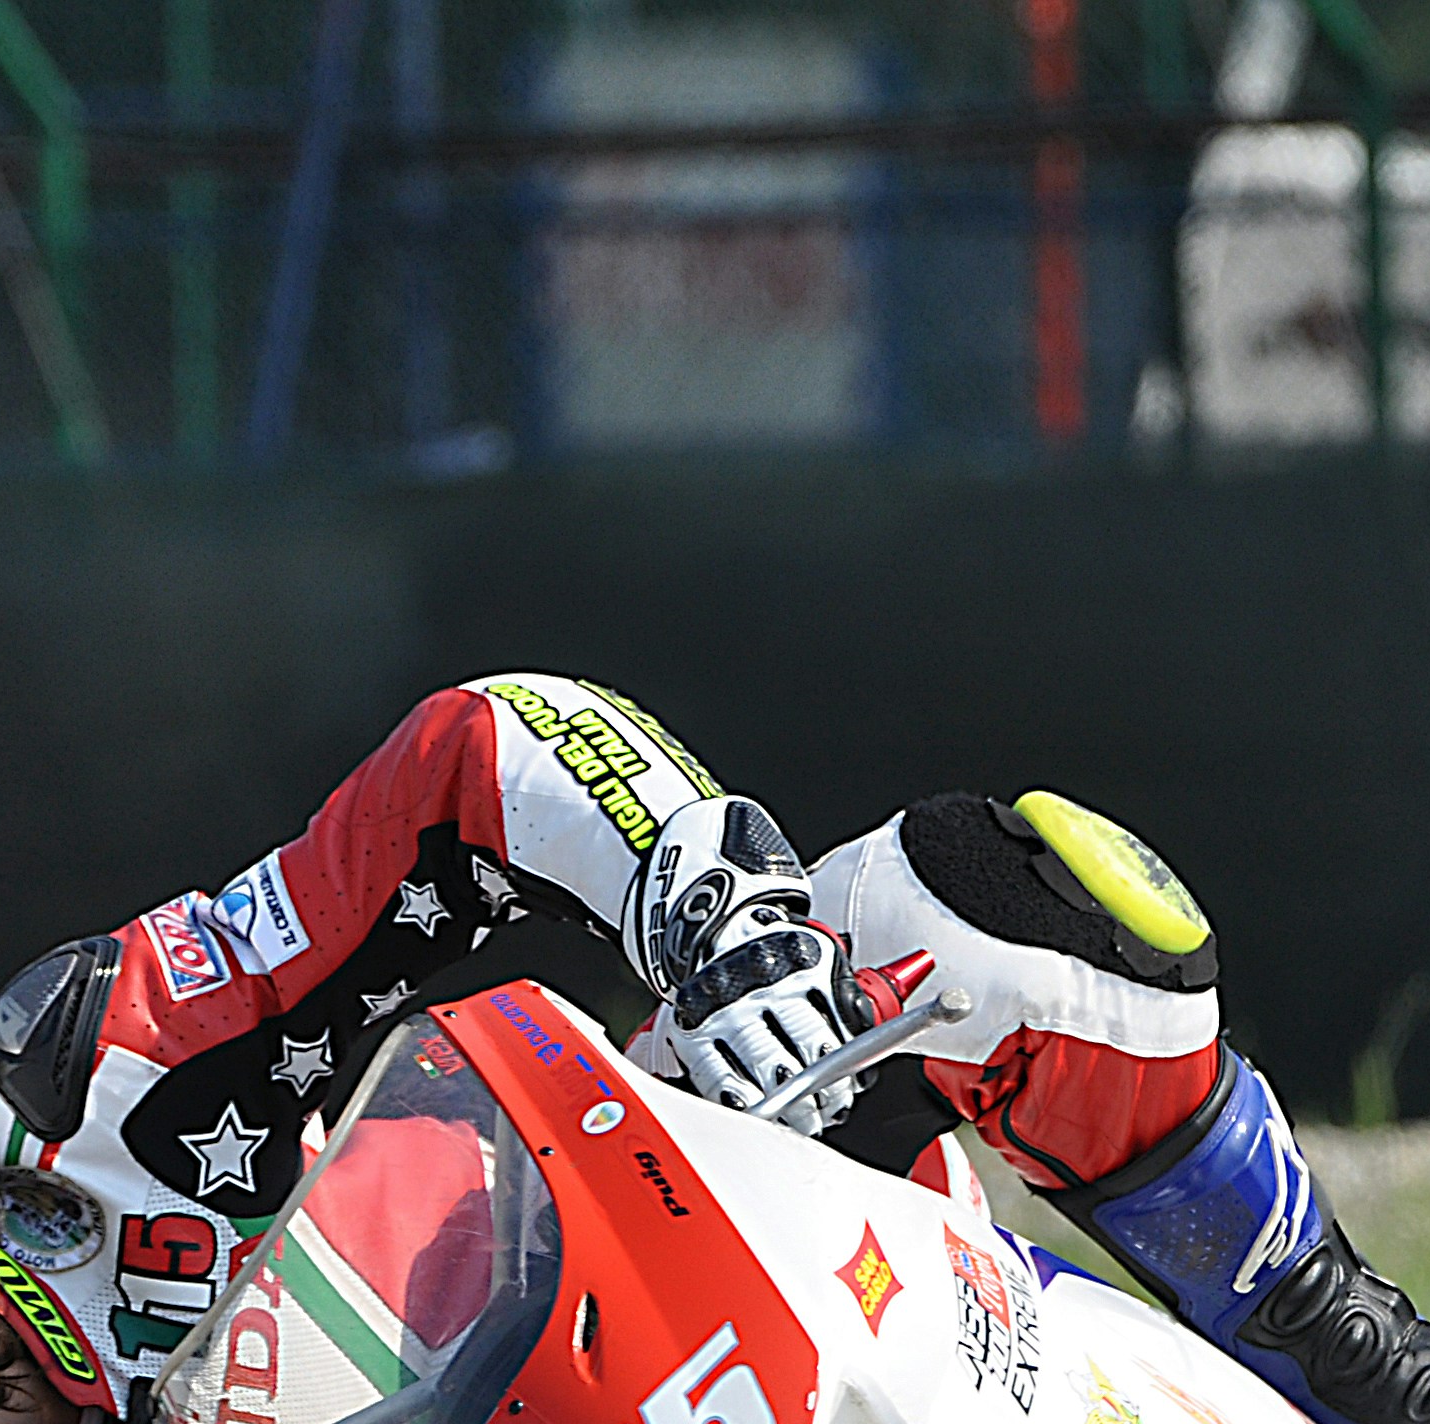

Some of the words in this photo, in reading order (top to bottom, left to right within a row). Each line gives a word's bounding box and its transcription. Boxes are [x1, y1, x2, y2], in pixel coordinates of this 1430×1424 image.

[488, 683, 570, 738] FUOCO
[558, 733, 610, 782] DEL
[569, 709, 647, 778] ITALIA
[649, 845, 683, 993] SPEED
[489, 993, 552, 1048] DUCATO
[634, 1151, 690, 1217] Puig
[13, 1249, 56, 1268] MOTO
[854, 1248, 880, 1289] SAN
[109, 1213, 218, 1360] 115
[861, 1261, 892, 1316] CARLO
[999, 1260, 1041, 1416] EXTREME
